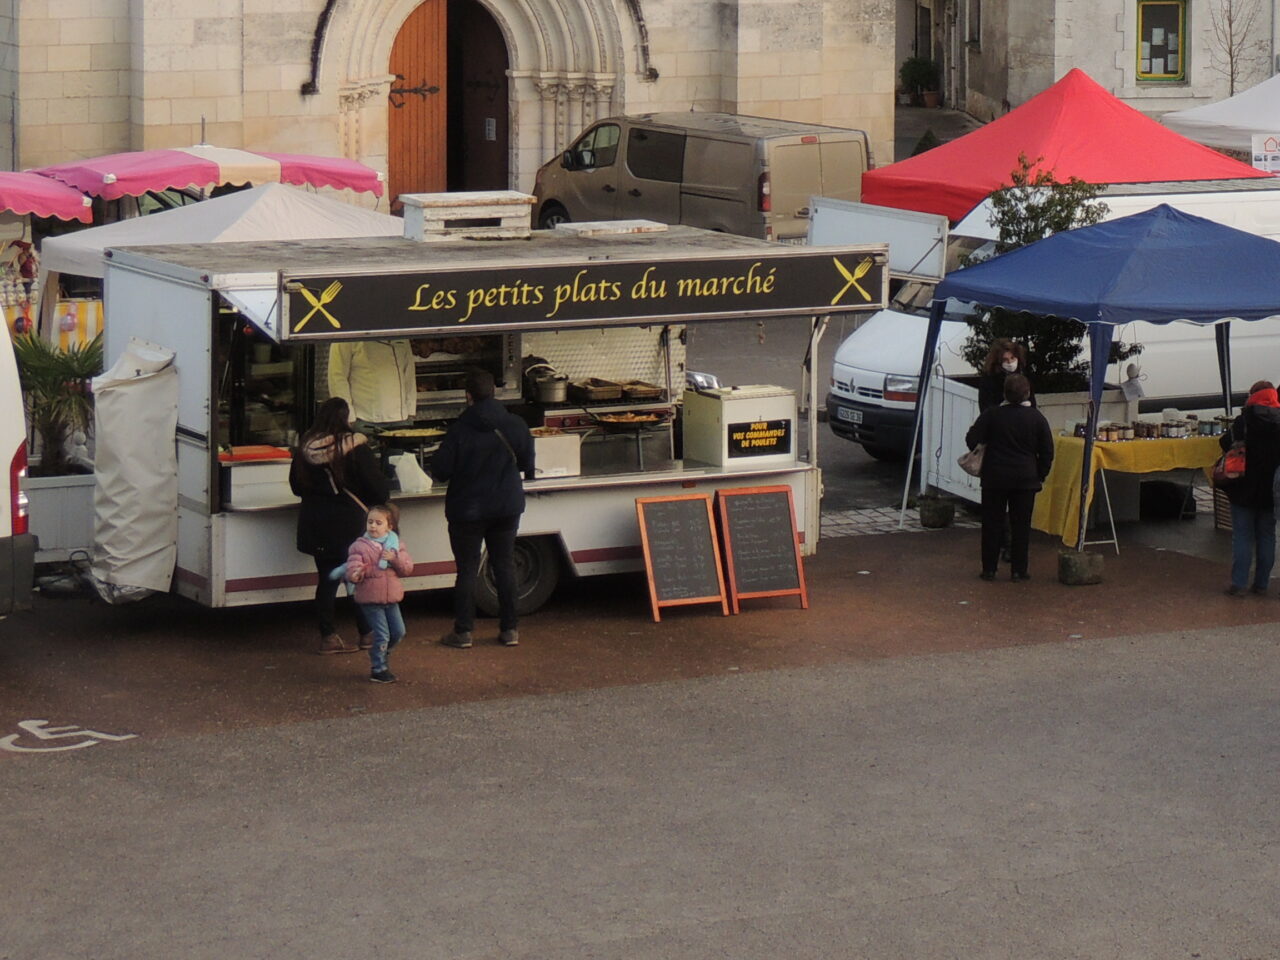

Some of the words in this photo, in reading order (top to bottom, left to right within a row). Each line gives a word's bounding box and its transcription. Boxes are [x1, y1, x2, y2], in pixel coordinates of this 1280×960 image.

[408, 284, 457, 311] Les
[458, 280, 544, 322] petits
[545, 269, 621, 318] plats
[631, 266, 667, 300] du
[677, 262, 777, 297] marché
[750, 422, 767, 430] POUR
[733, 432, 745, 440] VOS
[745, 429, 785, 439] COMMANDES
[741, 440, 750, 448] DE
[751, 438, 777, 447] POULETS
